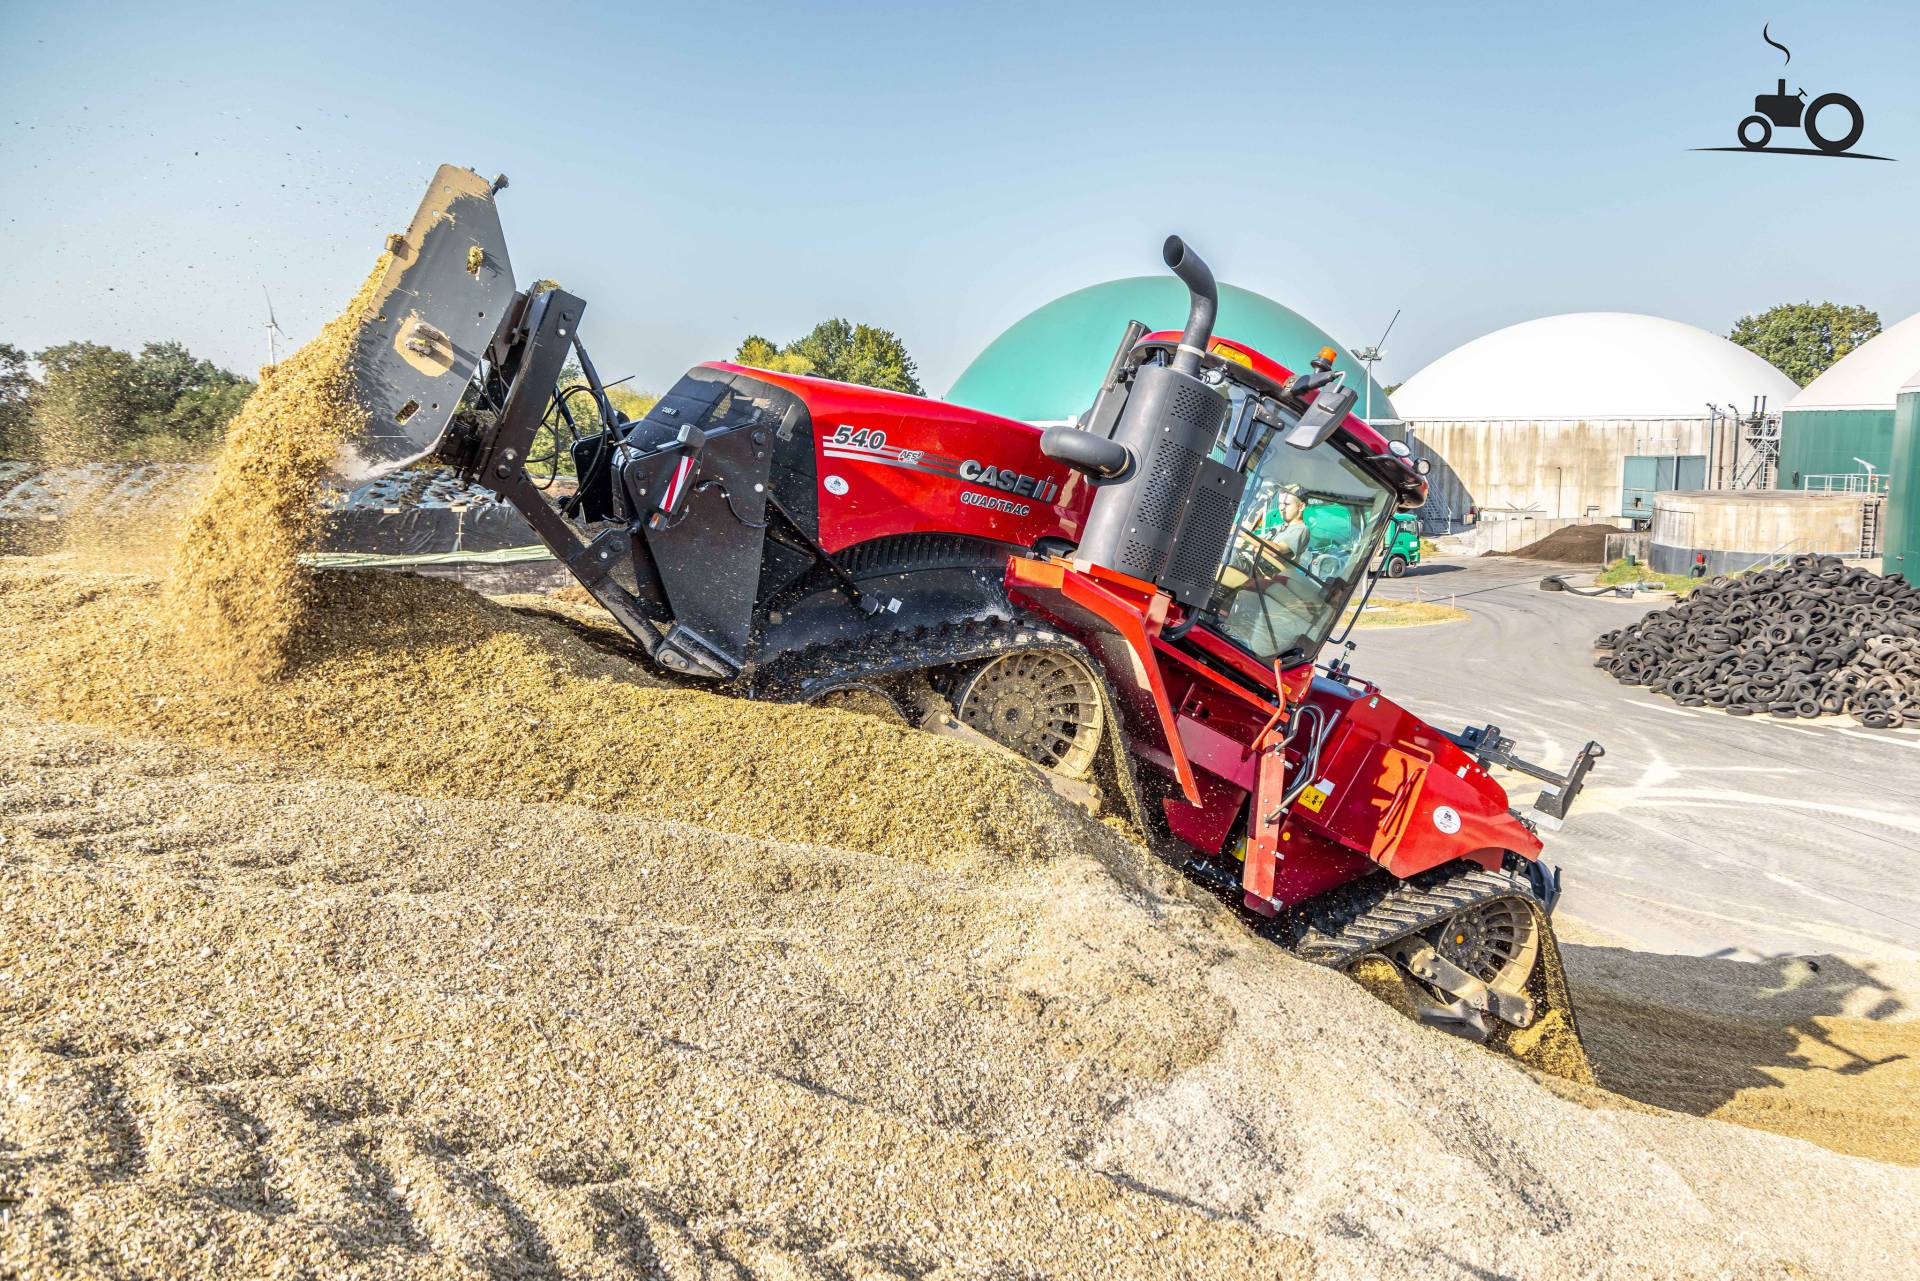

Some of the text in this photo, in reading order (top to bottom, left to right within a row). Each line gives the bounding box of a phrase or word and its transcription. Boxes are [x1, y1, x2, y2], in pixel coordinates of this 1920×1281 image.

[833, 424, 887, 450] 540
[960, 460, 1035, 496] CASE
[961, 491, 1030, 516] QUADTRAC
